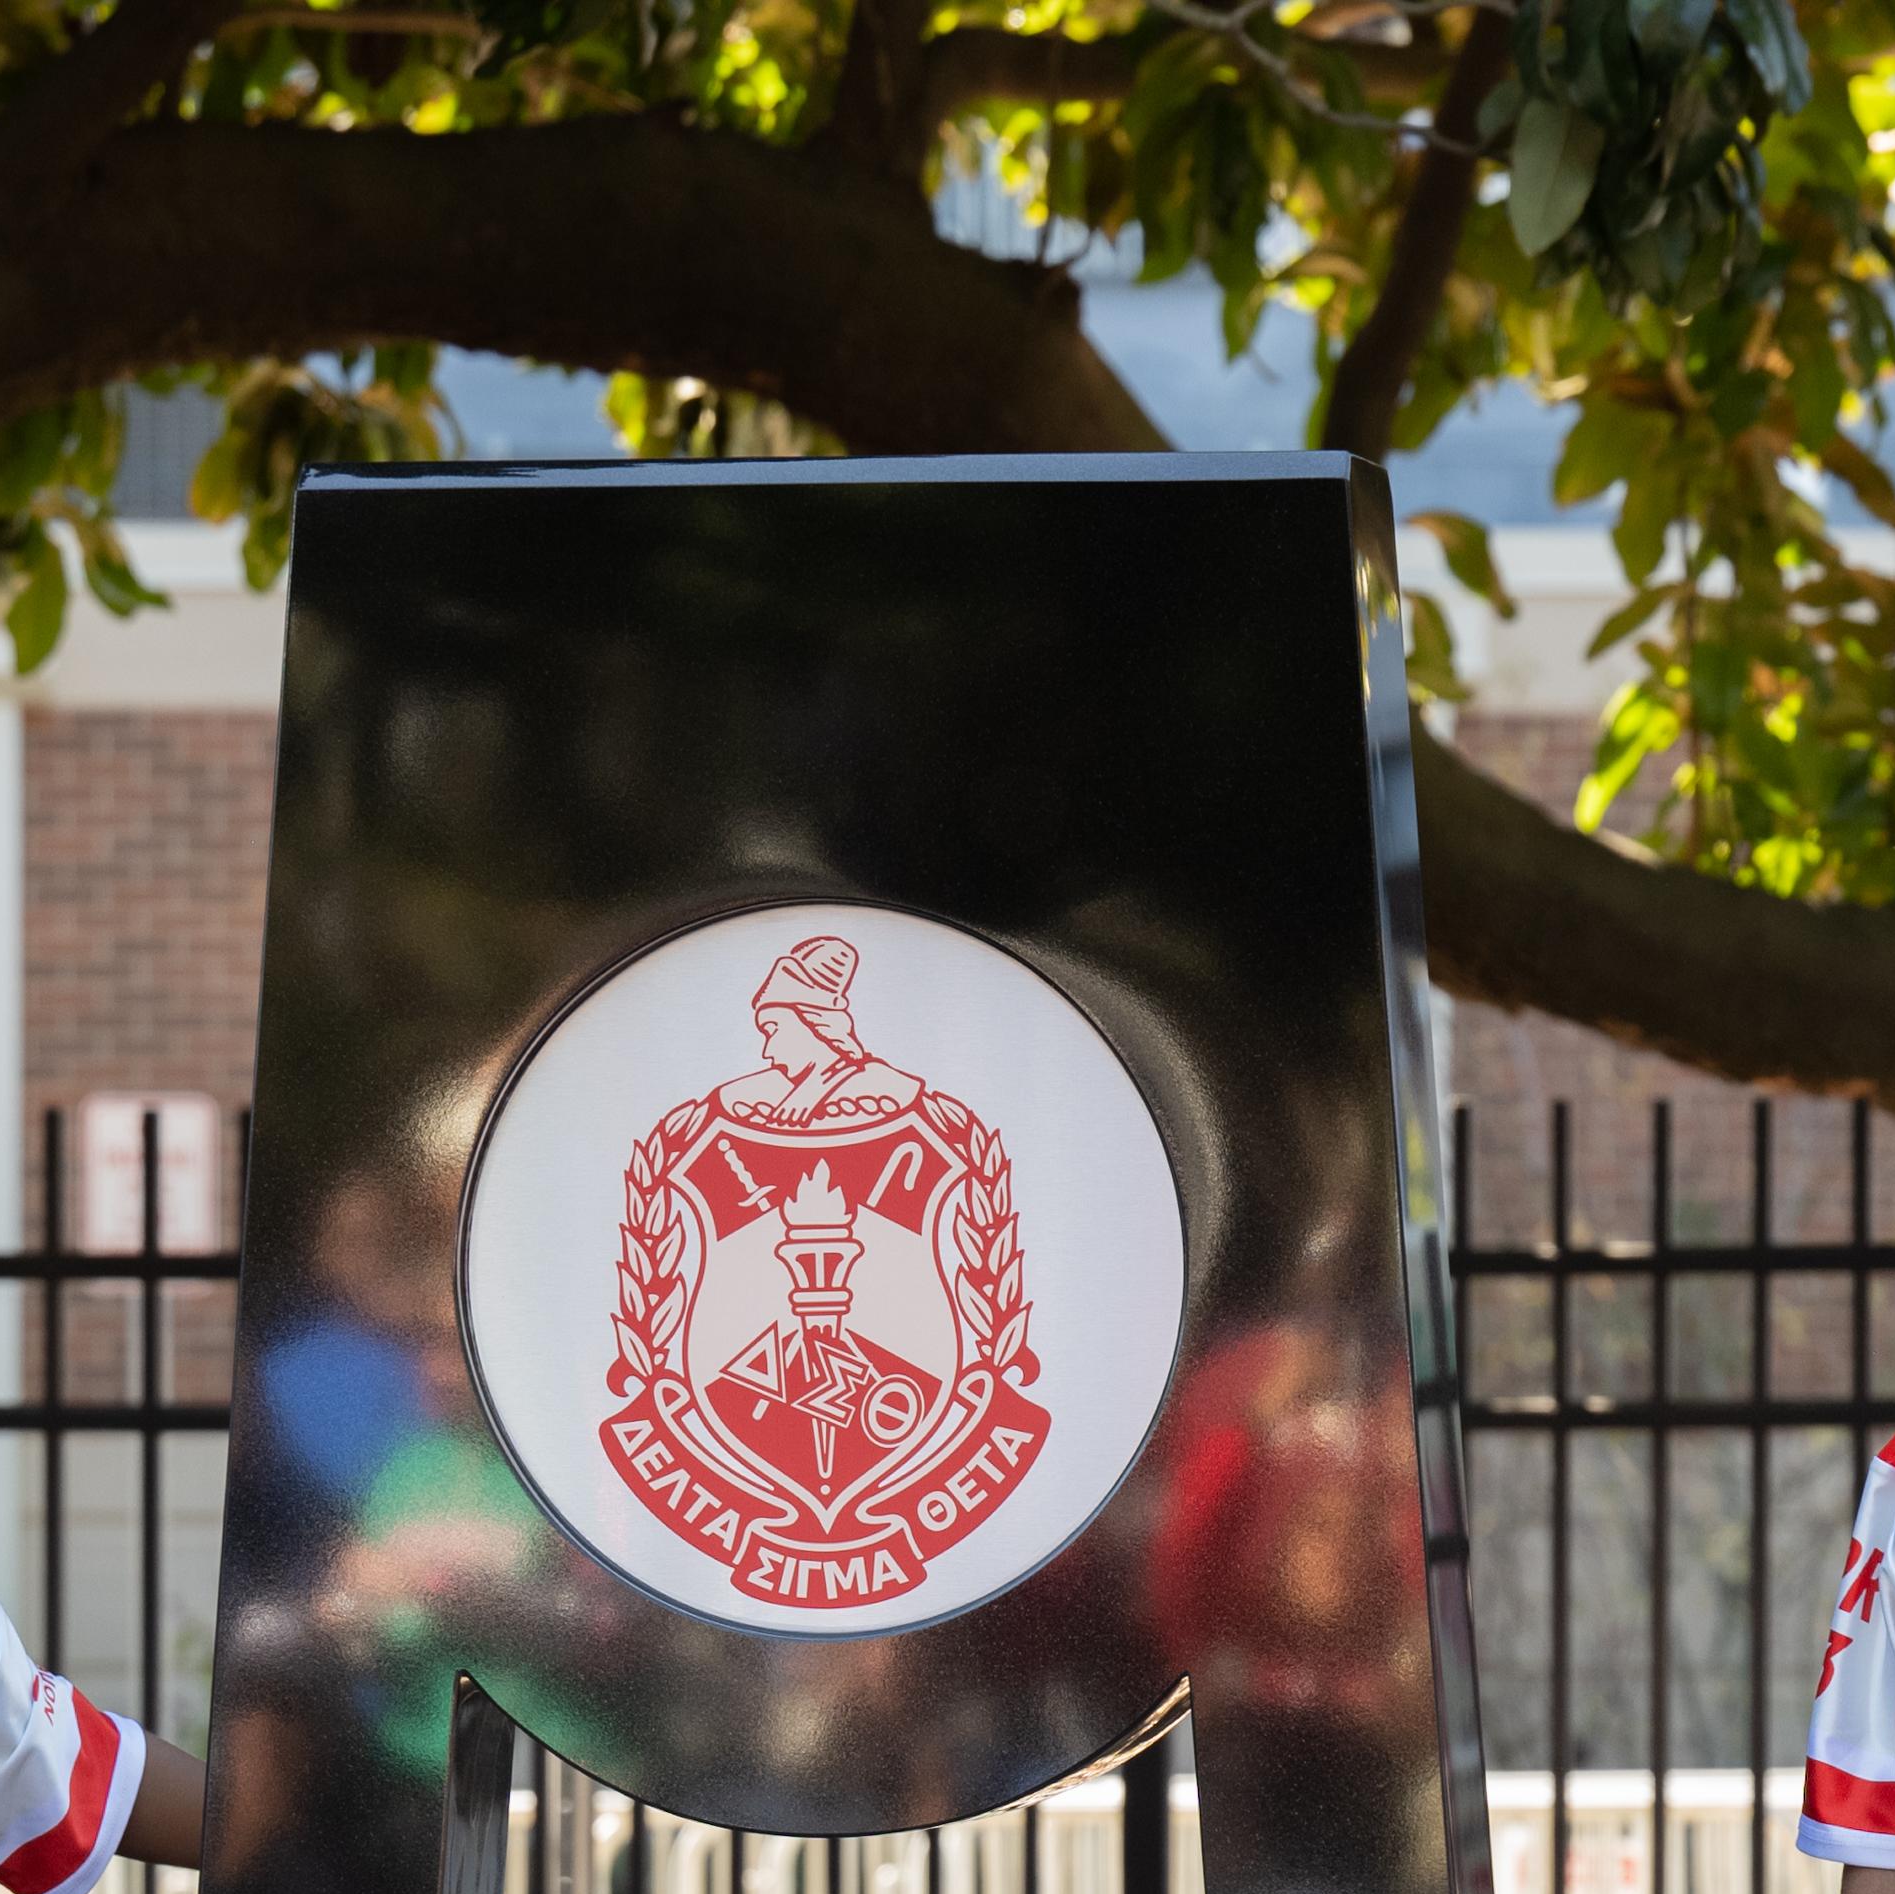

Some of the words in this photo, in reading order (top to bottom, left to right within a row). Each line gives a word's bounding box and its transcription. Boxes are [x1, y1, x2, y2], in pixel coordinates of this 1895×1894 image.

[610, 1419, 741, 1551] ΔΕΛΤΑ
[747, 1546, 909, 1600] ΣΙΓΜΑ
[916, 1425, 1035, 1533] ΘΕΤΑ
